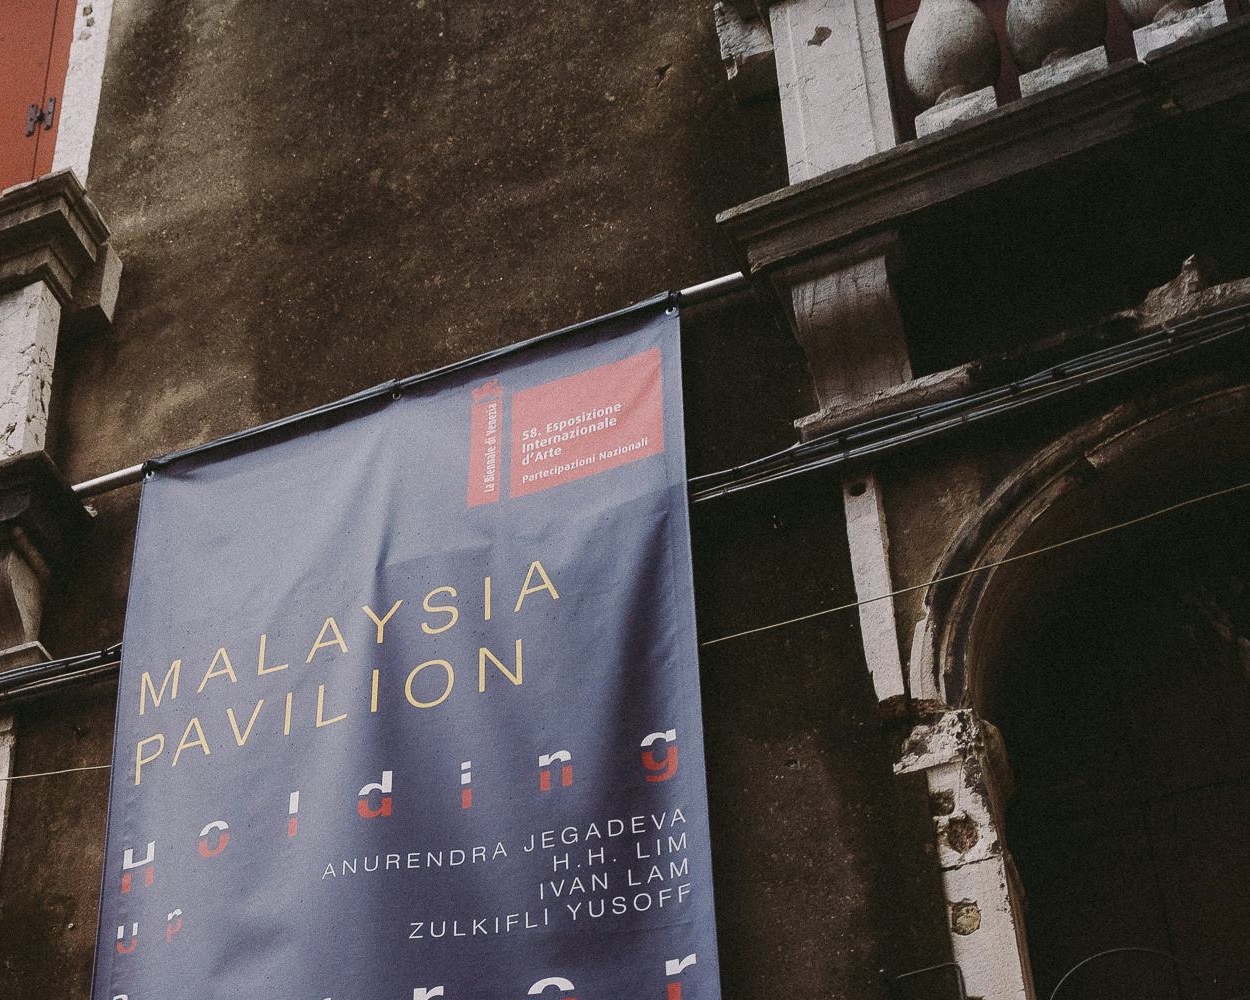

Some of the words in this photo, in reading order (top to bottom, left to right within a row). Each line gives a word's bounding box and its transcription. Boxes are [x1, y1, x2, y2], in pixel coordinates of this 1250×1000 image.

[485, 436, 496, 445] di
[486, 403, 497, 436] Venezia
[521, 417, 617, 454] Internazionale
[522, 427, 542, 441] 58.
[546, 403, 622, 433] Esposizione
[483, 446, 496, 482] Biennale
[522, 454, 596, 483] Partecipazioni
[598, 437, 648, 461] Nazionali
[139, 560, 559, 715] MALAYSIA
[135, 639, 523, 786] PAVILION
[121, 728, 679, 894] Holding
[321, 842, 508, 880] ANURENDRA
[524, 808, 686, 853] JEGADEVA
[553, 847, 617, 872] H.H.
[637, 832, 687, 860] LIM
[540, 872, 608, 900] IVAN
[627, 858, 689, 886] LAM
[408, 908, 549, 939] ZULKIFLI
[566, 883, 691, 921] YUSOFF
